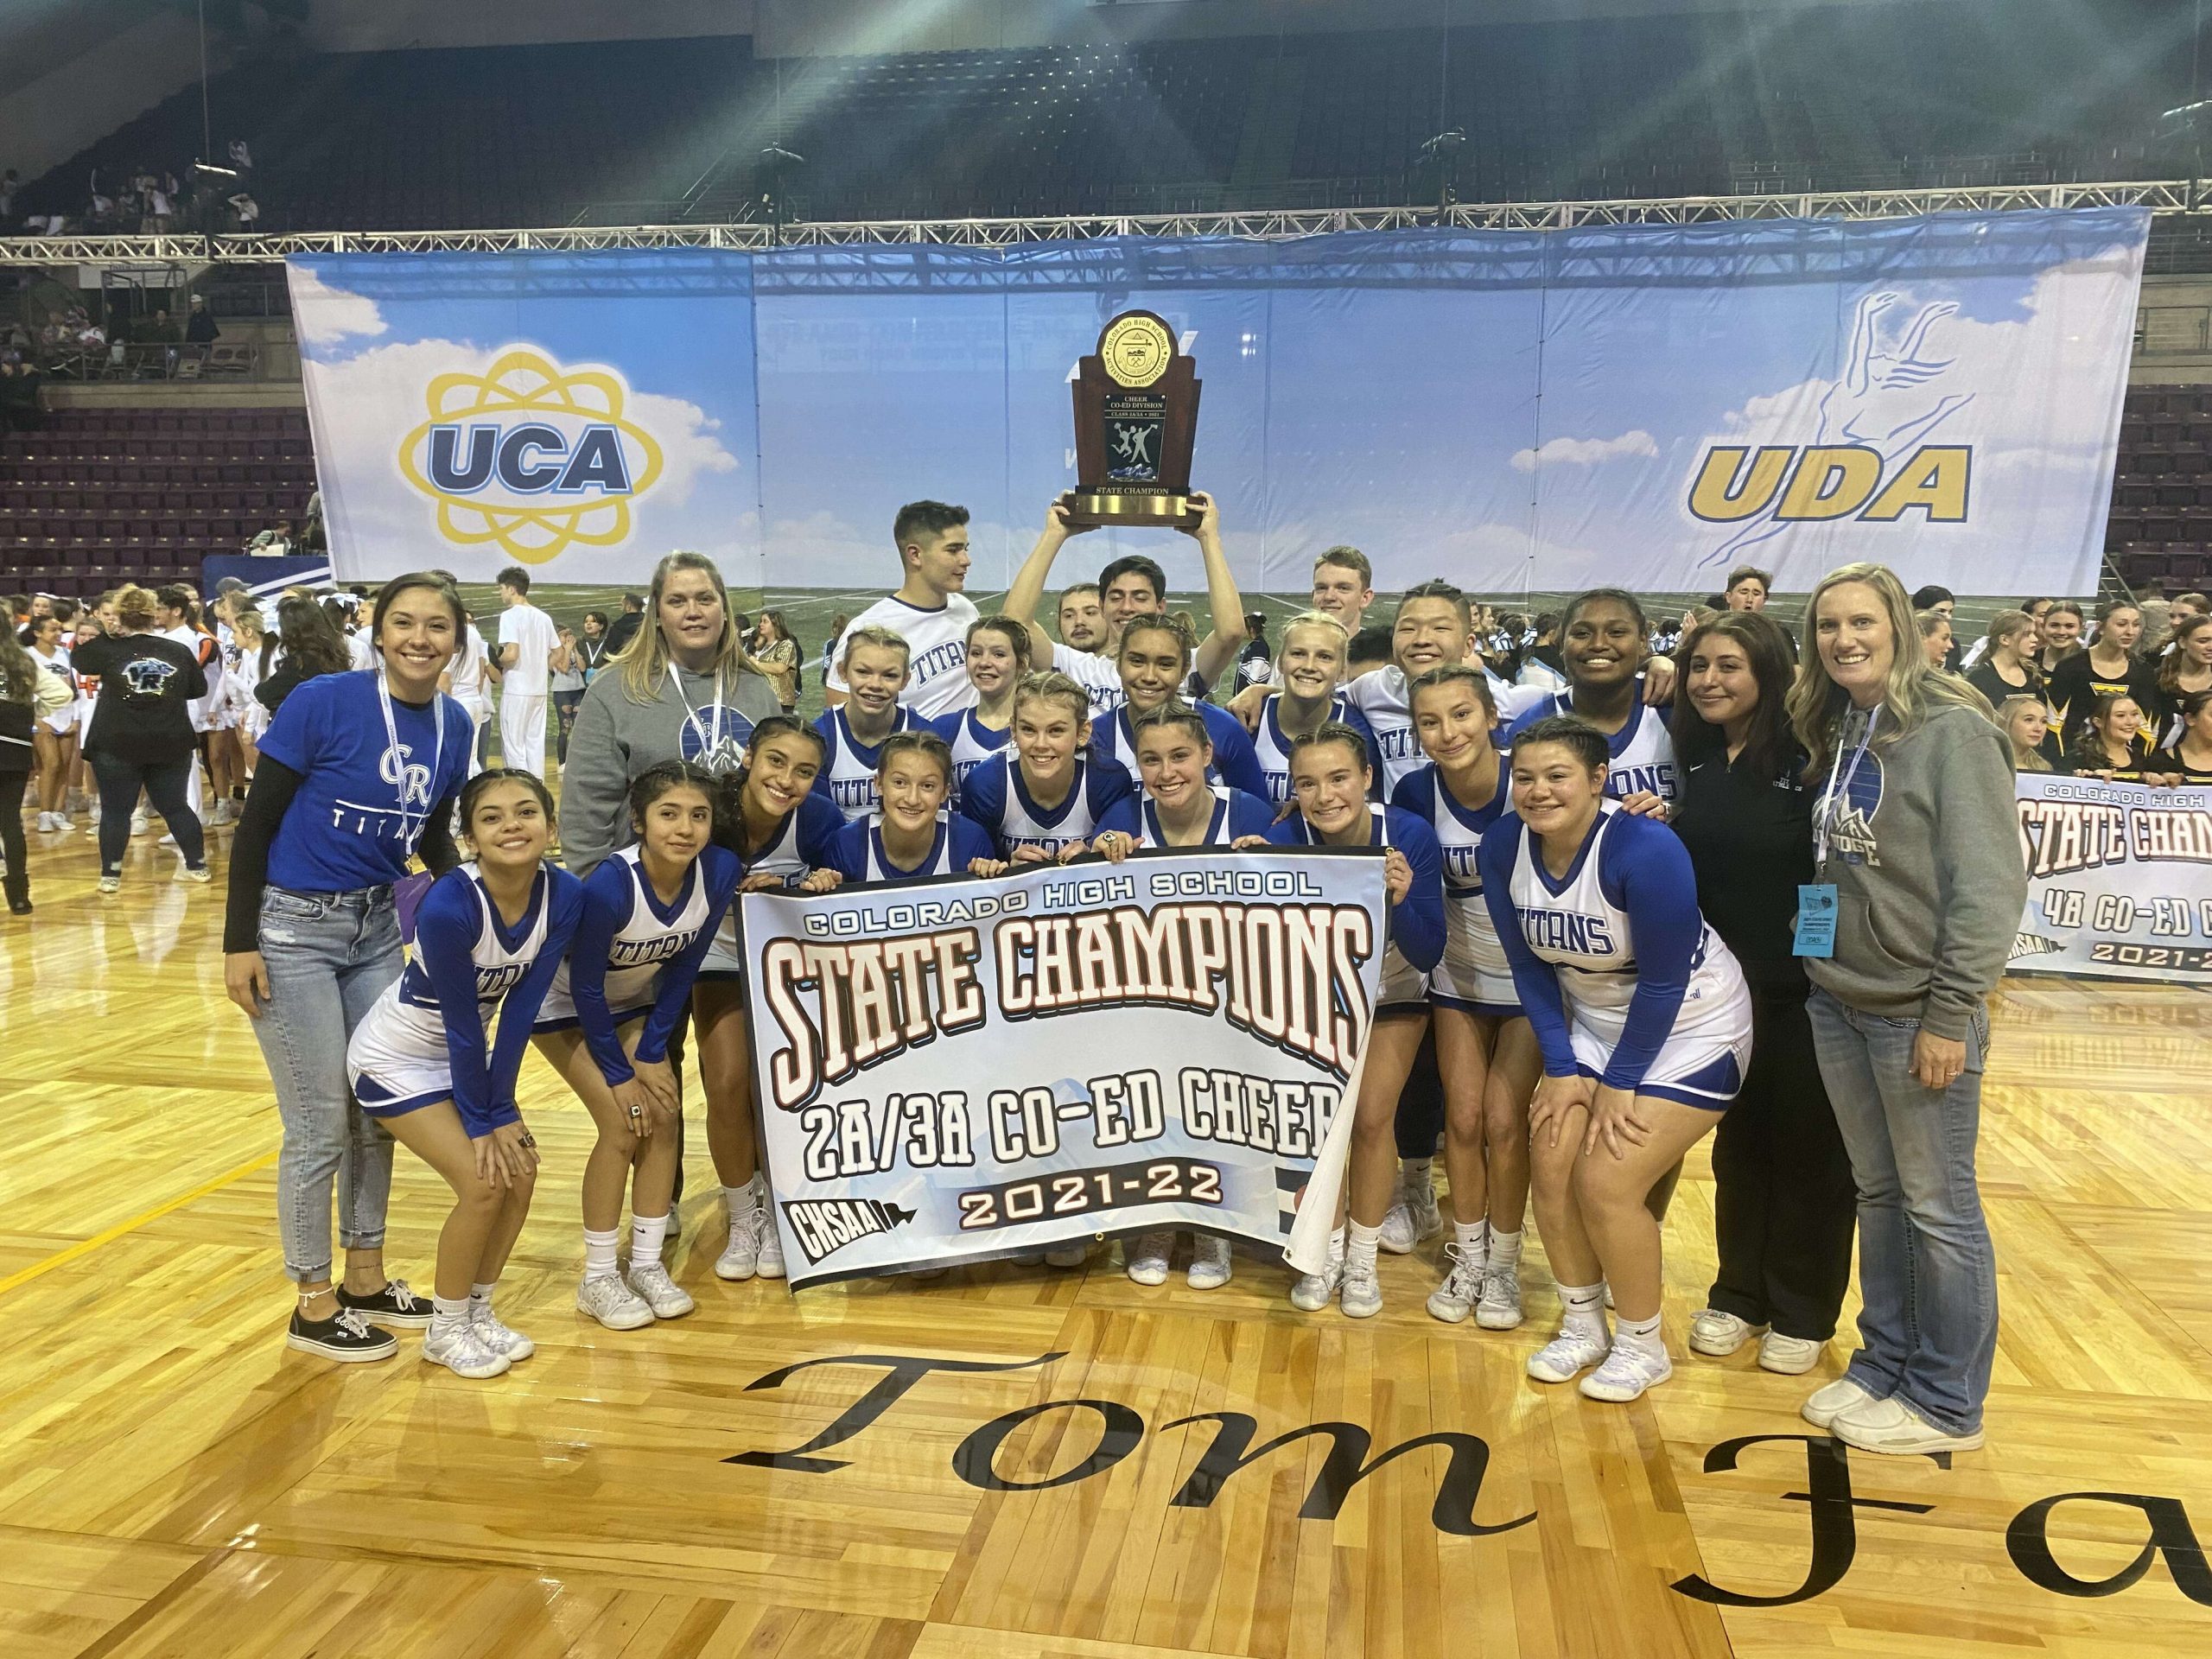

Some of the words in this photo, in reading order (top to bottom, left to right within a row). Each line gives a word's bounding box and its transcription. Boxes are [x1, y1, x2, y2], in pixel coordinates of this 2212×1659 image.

[1107, 321, 1132, 349] COLORADO
[1134, 319, 1151, 328] HIGH
[1152, 325, 1167, 350] SCHOOL
[1106, 357, 1132, 385] ACTIVITIES
[1134, 356, 1166, 385] ASSOCIATION
[429, 422, 633, 495] UCA
[1096, 486, 1122, 495] STATE
[1123, 486, 1169, 495] CHAMPION
[1688, 444, 1974, 523] UDA
[2044, 784, 2145, 805] COLORADO
[2151, 794, 2204, 808] HIGH
[2016, 798, 2127, 881] STATE
[804, 889, 1028, 937] COLORADO
[1043, 873, 1135, 908] HIGH
[1149, 870, 1323, 900] SCHOOL
[2042, 888, 2086, 929] 4A
[2093, 894, 2192, 937] CO-ED
[764, 925, 986, 1112] STATE
[994, 902, 1373, 1084] CHAMPIONS
[802, 1090, 975, 1181] 2A/3A
[990, 1069, 1163, 1163] CO-ED
[1178, 1068, 1344, 1160] CHEER
[959, 1161, 1223, 1230] 2021-22
[789, 1201, 880, 1259] CHSAA
[717, 1350, 1539, 1537] Tom
